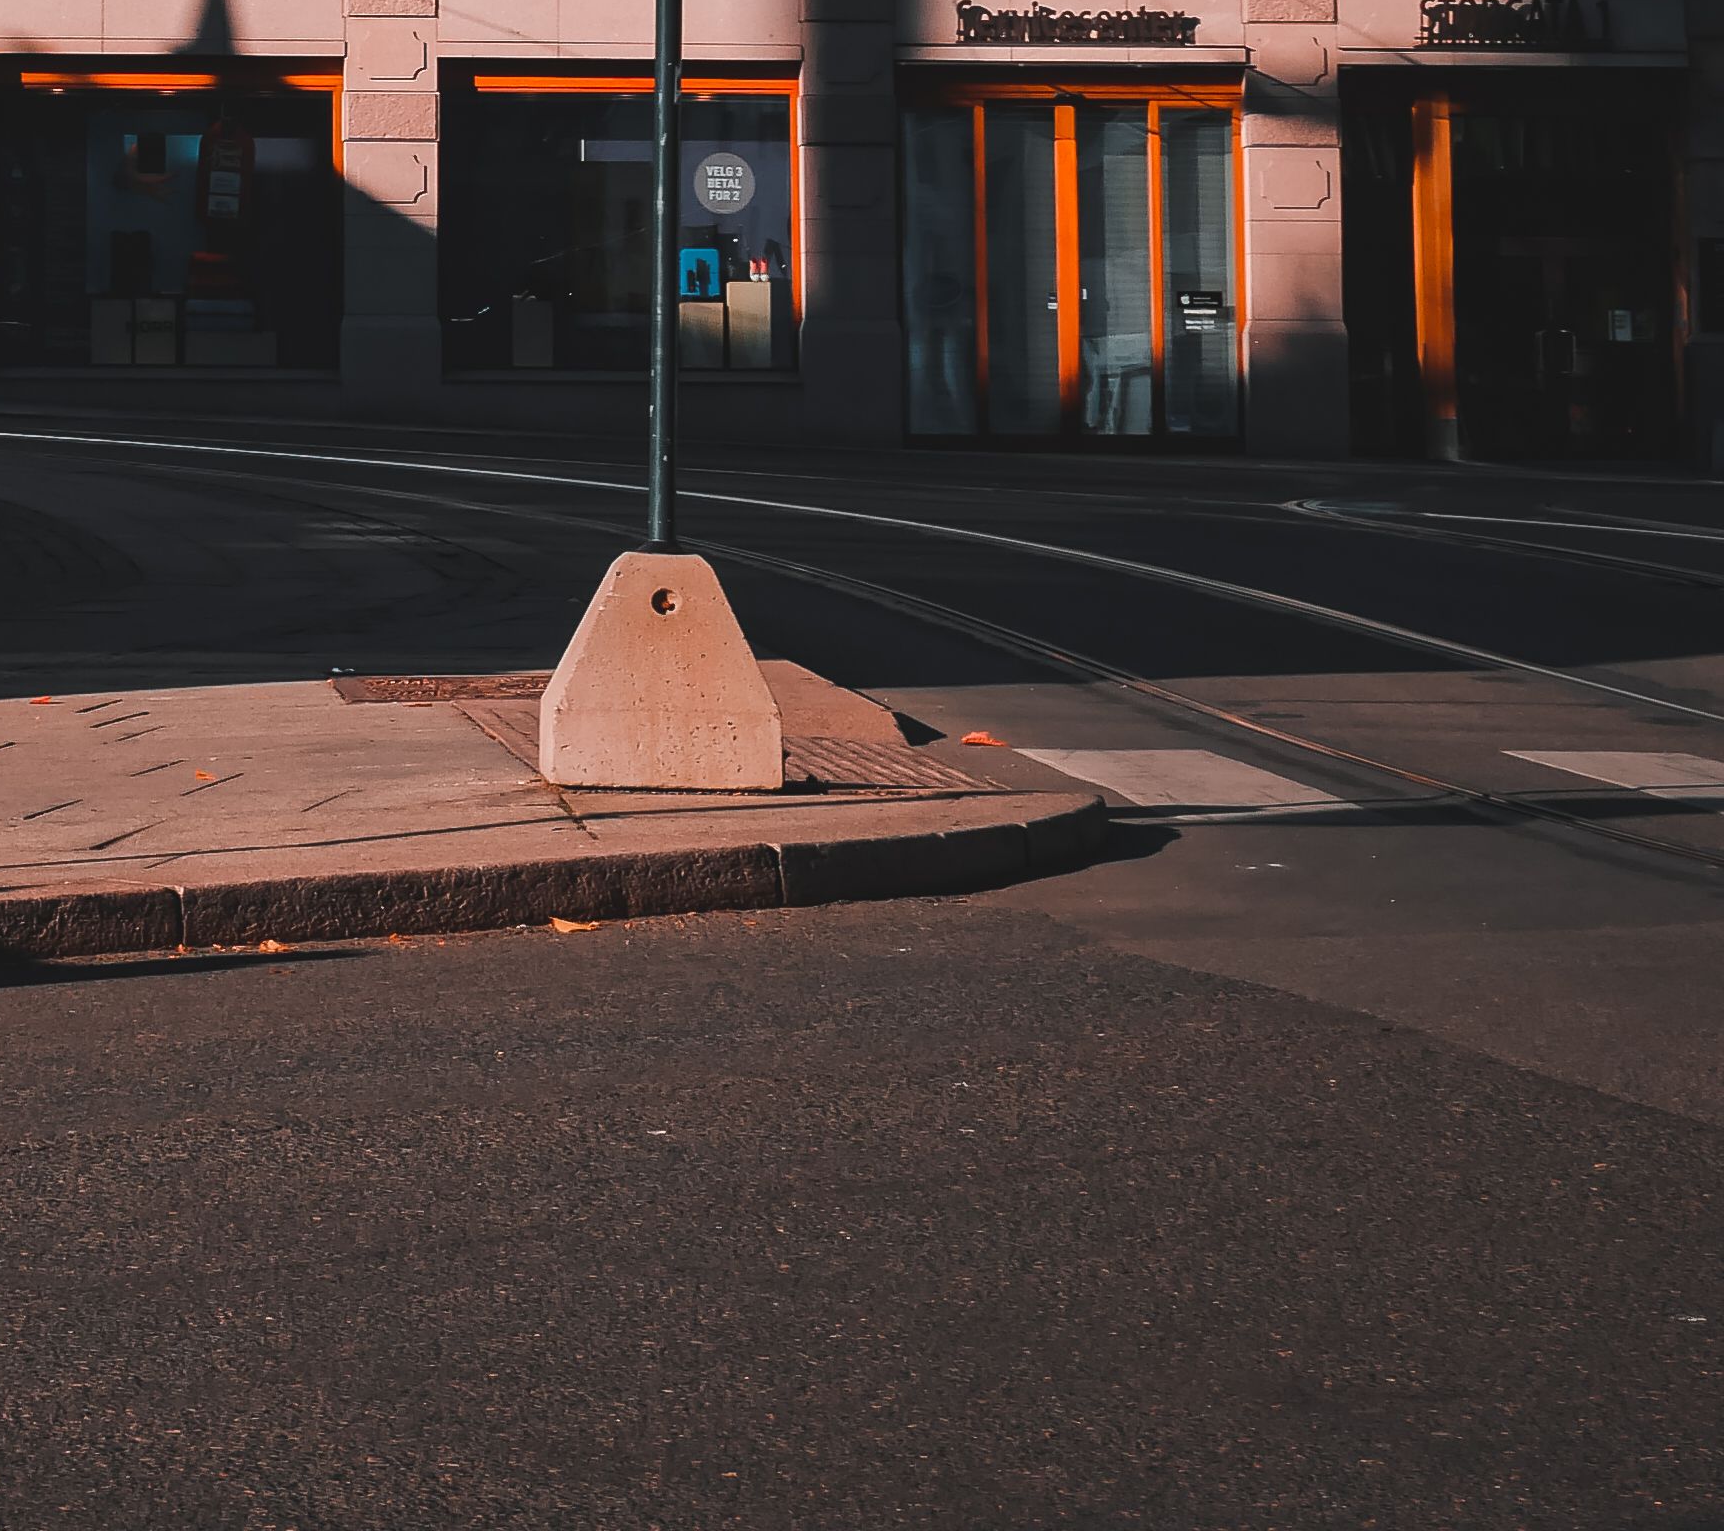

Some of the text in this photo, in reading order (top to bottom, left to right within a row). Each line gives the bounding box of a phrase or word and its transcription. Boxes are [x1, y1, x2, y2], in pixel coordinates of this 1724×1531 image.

[705, 166, 743, 177] VELG 3
[707, 178, 741, 188] BETAL
[708, 190, 740, 201] FOR 2
